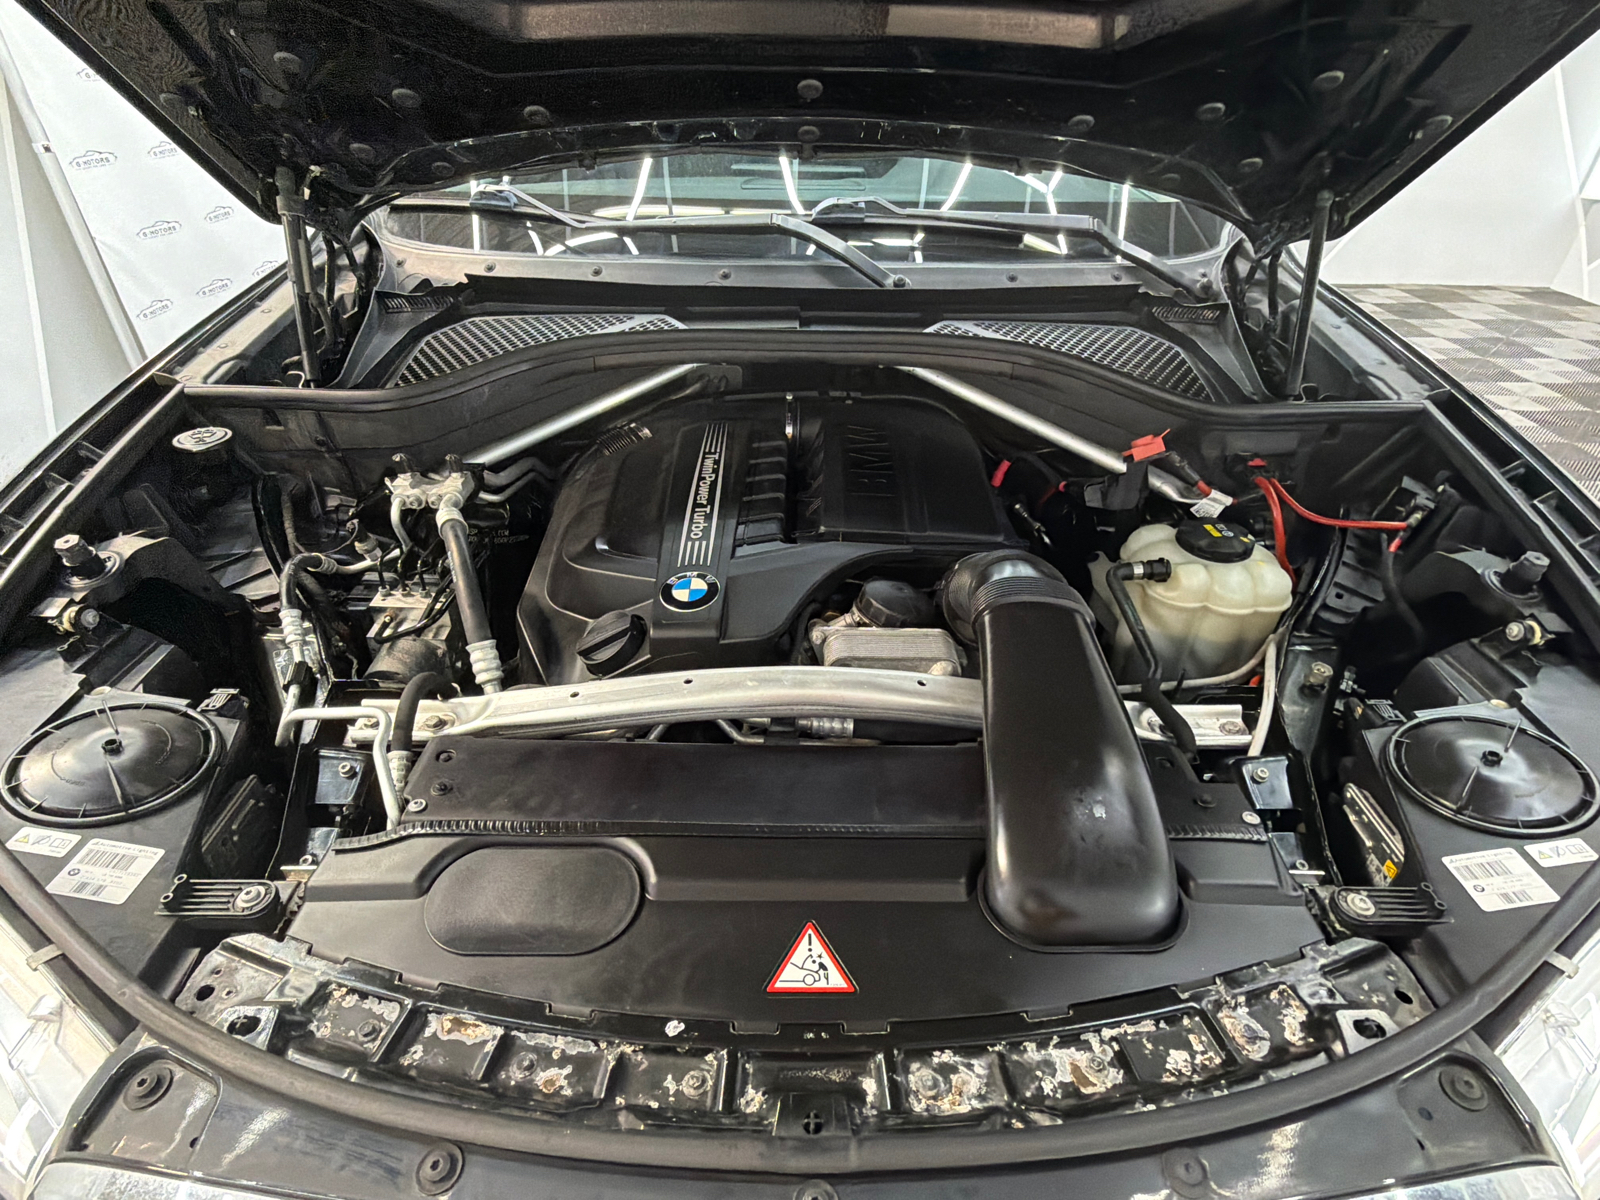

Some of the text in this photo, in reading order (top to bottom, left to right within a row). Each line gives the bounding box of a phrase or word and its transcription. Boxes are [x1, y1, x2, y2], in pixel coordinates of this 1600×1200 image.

[690, 452, 719, 539] TwinPower Turbo
[845, 424, 896, 497] BMW
